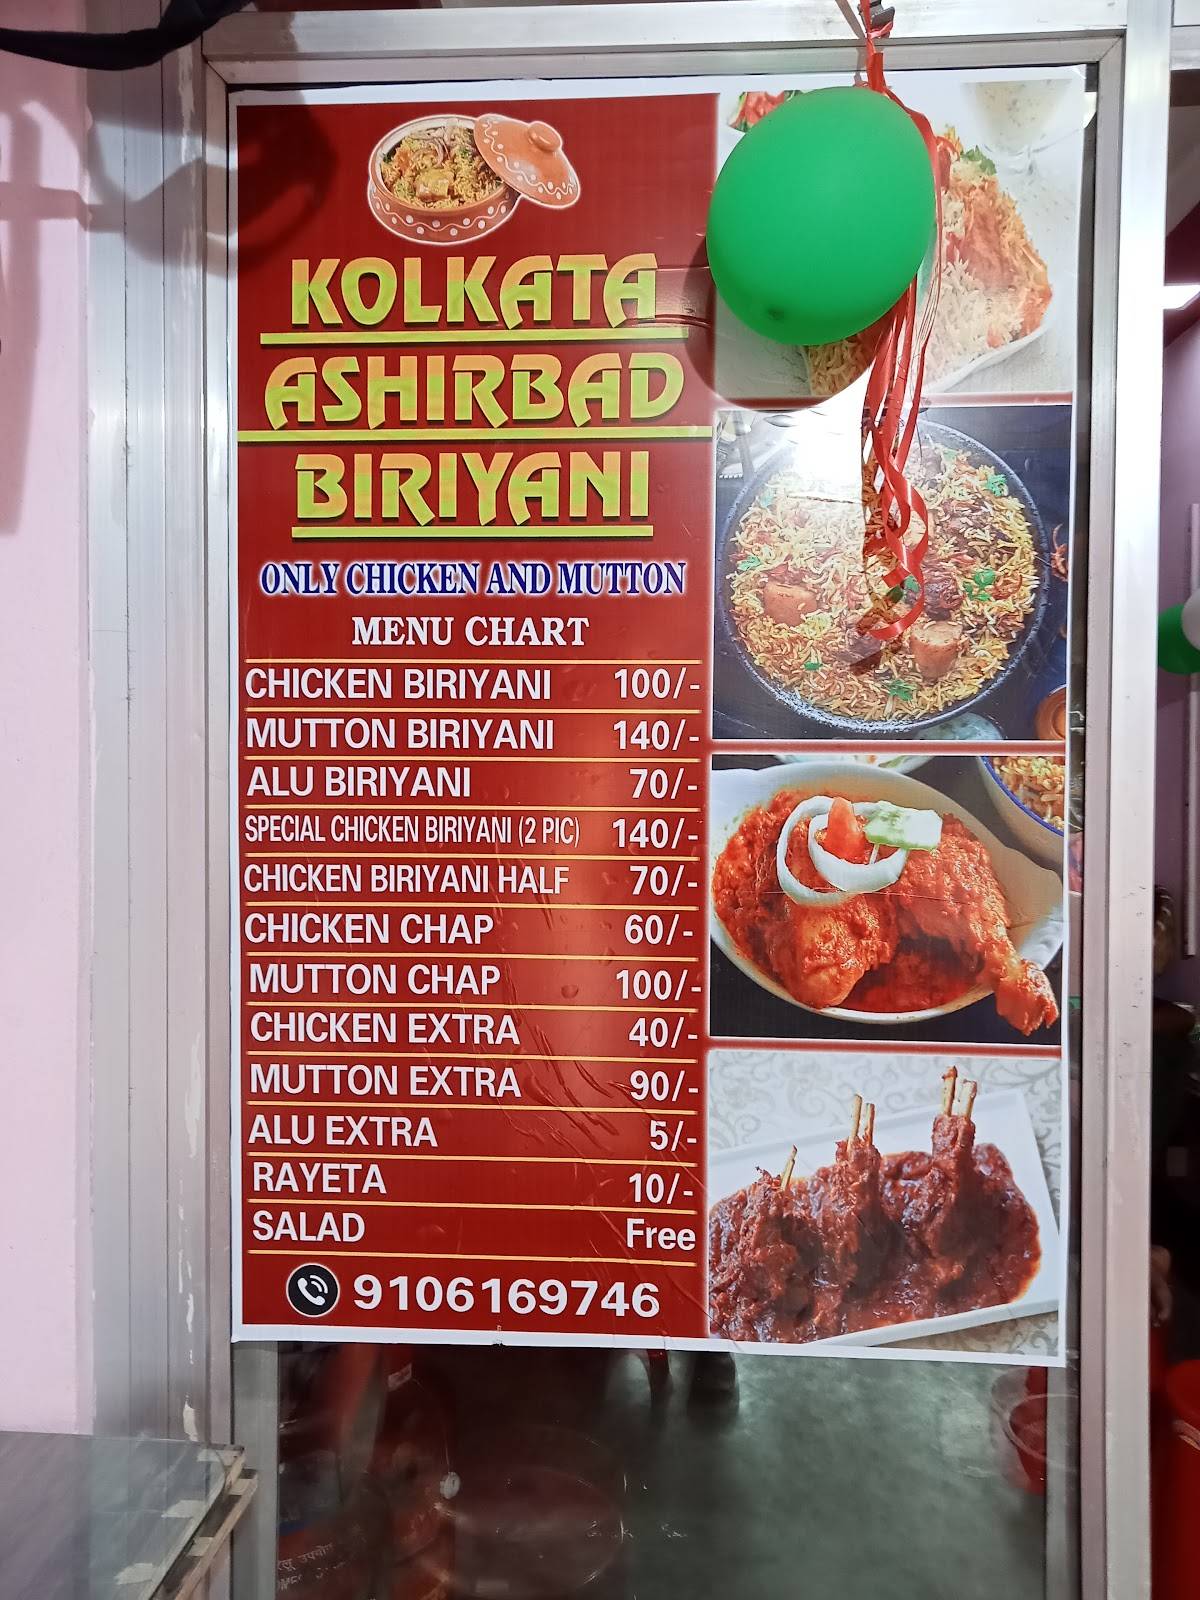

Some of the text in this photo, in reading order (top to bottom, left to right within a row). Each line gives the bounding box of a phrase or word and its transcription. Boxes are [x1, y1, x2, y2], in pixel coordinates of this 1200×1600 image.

[291, 252, 657, 329] KOLKATA
[264, 352, 684, 430] ASHIRBAD
[295, 450, 649, 526] BIRIYANI
[261, 561, 686, 595] ONLY CHICKEN AND MUTTON
[351, 615, 590, 647] MENU CHART
[245, 666, 700, 700] CHICKEN BIRIYANI 100/-
[246, 717, 700, 751] MUTTON BIRIYANI 140/-
[246, 766, 698, 800] ALU BIRIYANI 70/-
[245, 814, 699, 849] SPECIAL CHICKEN BIRIYANI (2 PIC) 140/-
[243, 863, 698, 897] CHICKEN BIRIYANI HALF 70/-
[244, 912, 693, 946] CHICKEN CHAP 60/-
[250, 963, 702, 1001] MUTTON CHAP 100/-
[250, 1011, 698, 1049] CHICKEN EXTRA 40/-
[250, 1063, 699, 1102] MUTTON EXTRA 90/-
[248, 1114, 697, 1152] ALU EXTRA 5/-
[253, 1161, 693, 1205] RAYETA 10/-
[252, 1210, 696, 1251] SALAD Free
[353, 1274, 660, 1318] 9106169746
